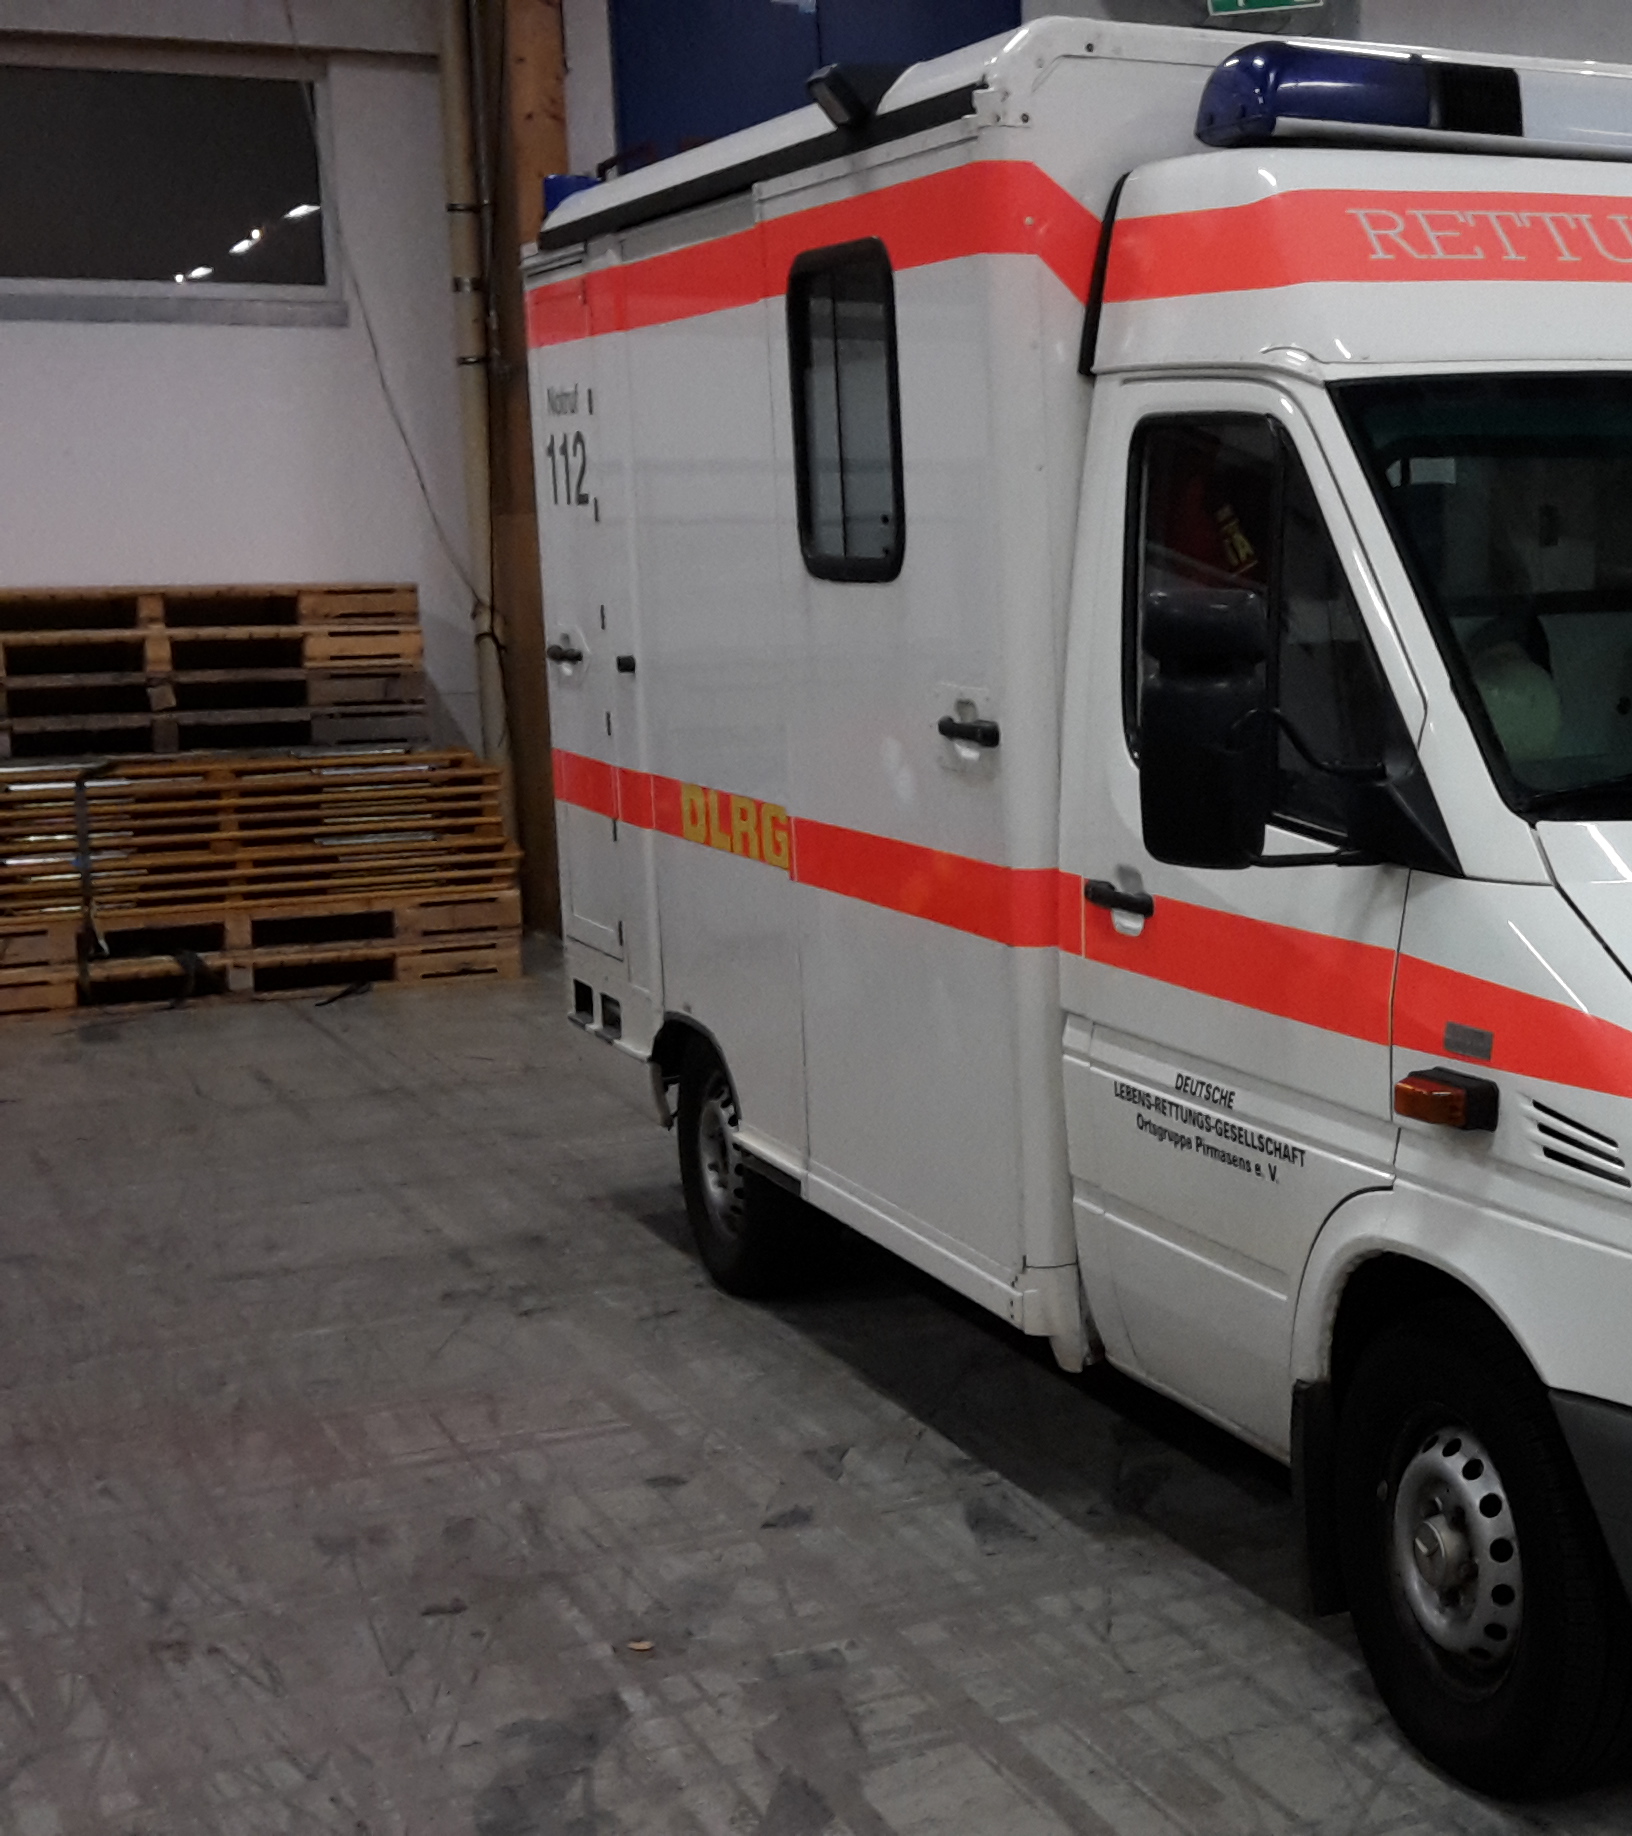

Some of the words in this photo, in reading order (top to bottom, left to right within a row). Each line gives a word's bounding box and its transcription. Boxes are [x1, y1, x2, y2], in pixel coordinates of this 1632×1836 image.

[546, 430, 590, 506] 112
[680, 782, 790, 871] DLRG
[1113, 1080, 1306, 1167] LEBENS-RETTUNGS-GESELLSCHAFT
[1175, 1073, 1236, 1110] DEUTSCHE
[1136, 1112, 1193, 1151] Ortsgruppe
[1195, 1135, 1252, 1173] Pirmasens
